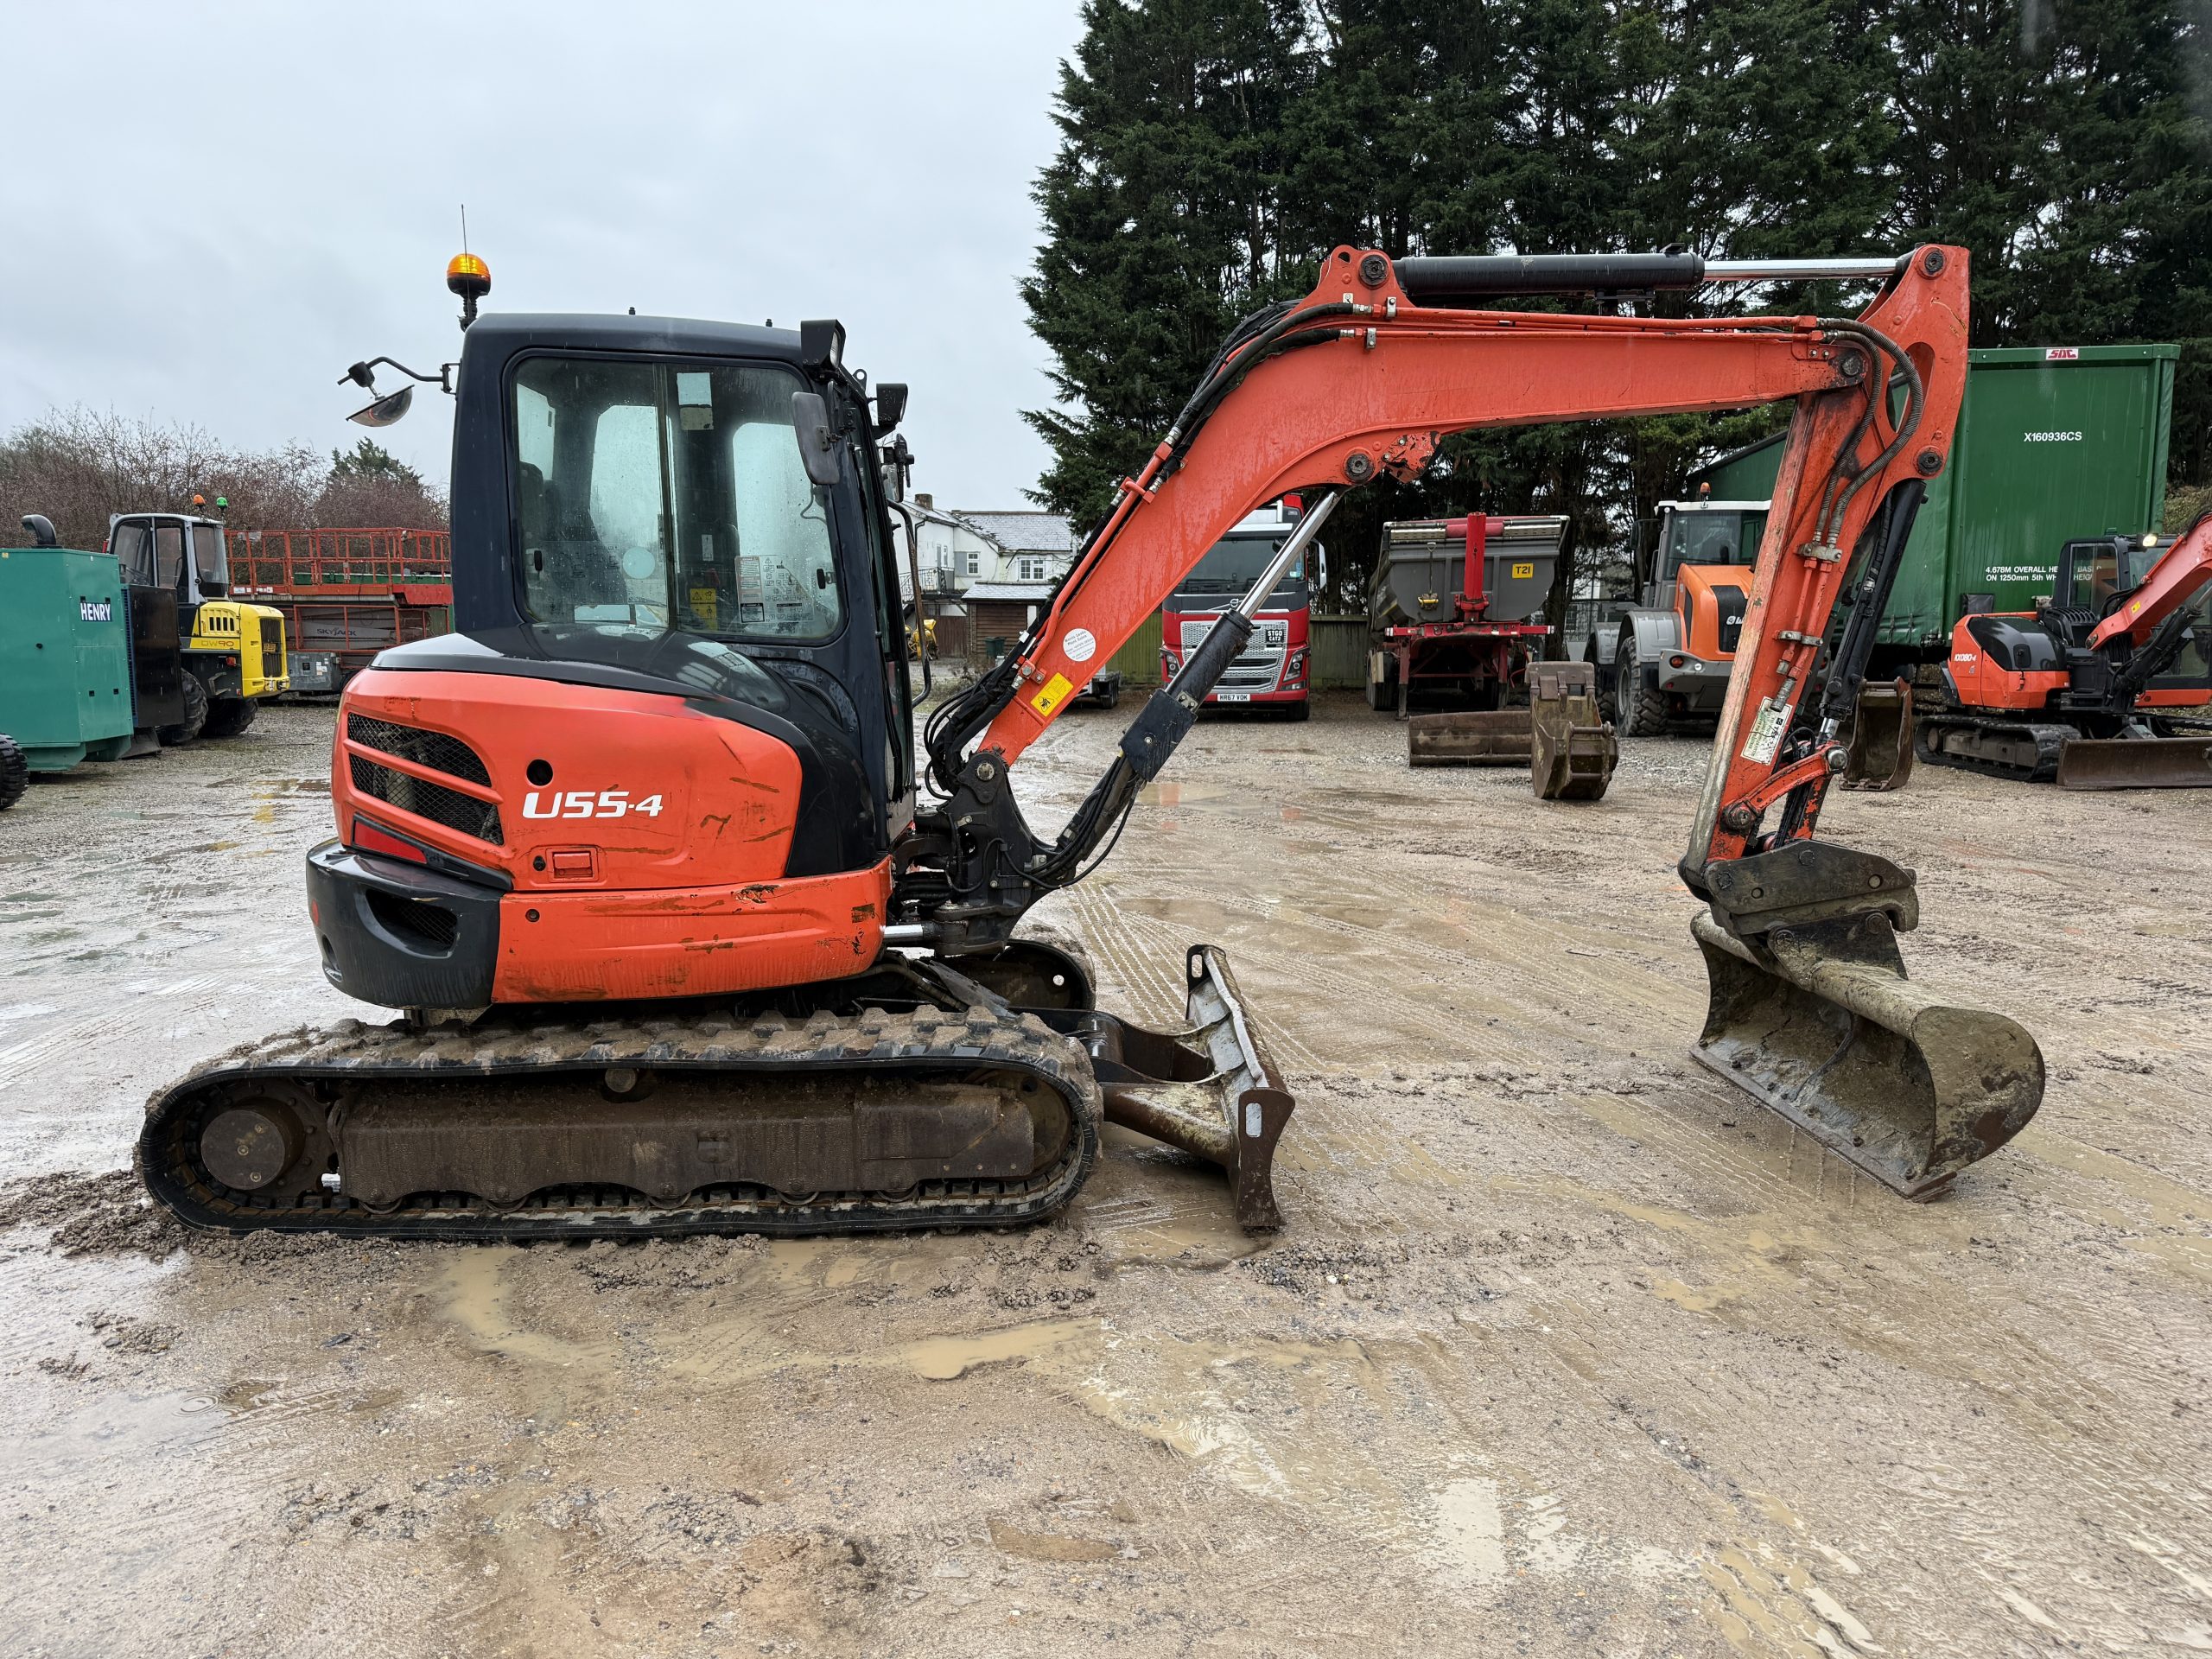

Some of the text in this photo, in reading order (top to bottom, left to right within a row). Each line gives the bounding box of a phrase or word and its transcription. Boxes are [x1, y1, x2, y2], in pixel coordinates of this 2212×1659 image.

[2048, 349, 2077, 359] SDC
[2024, 432, 2082, 442] X160936CS
[80, 602, 111, 620] HENRY
[522, 791, 664, 819] U55-4
